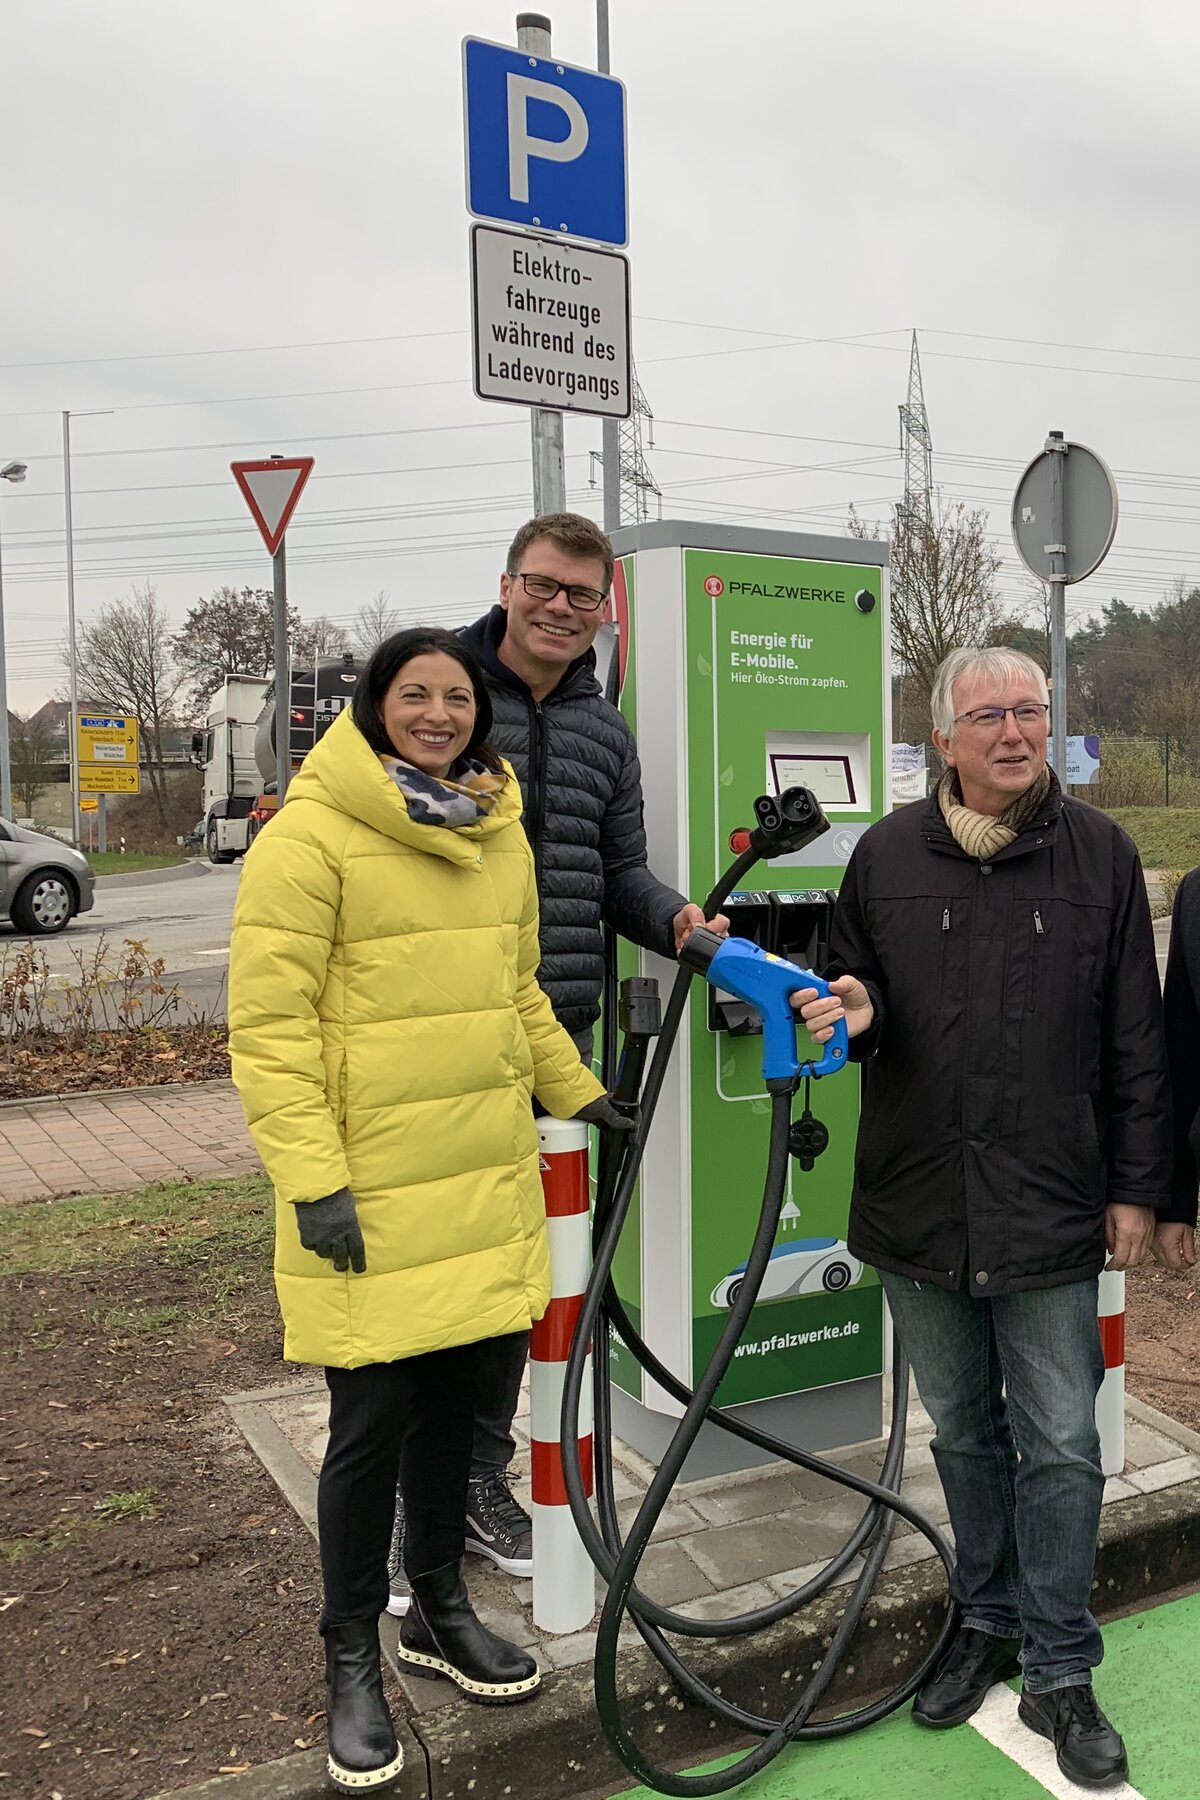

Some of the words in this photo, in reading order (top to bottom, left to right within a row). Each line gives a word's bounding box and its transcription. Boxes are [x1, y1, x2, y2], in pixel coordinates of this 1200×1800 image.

[506, 71, 590, 204] P
[513, 249, 592, 286] Elektro-
[505, 285, 601, 328] fahrzeuge
[491, 320, 574, 355] während
[583, 334, 616, 361] des
[487, 352, 620, 401] Ladevorgangs
[729, 581, 846, 603] PFALZWERKE
[730, 630, 787, 650] Energie
[790, 633, 813, 650] für
[730, 652, 799, 670] E-Mobile.
[730, 672, 753, 683] Hier
[755, 671, 809, 687] Öko-Strom
[811, 677, 849, 689] zapfen.
[753, 893, 763, 903] 1
[811, 891, 823, 901] 2
[734, 1320, 860, 1358] ww.pfalzwerke.de
